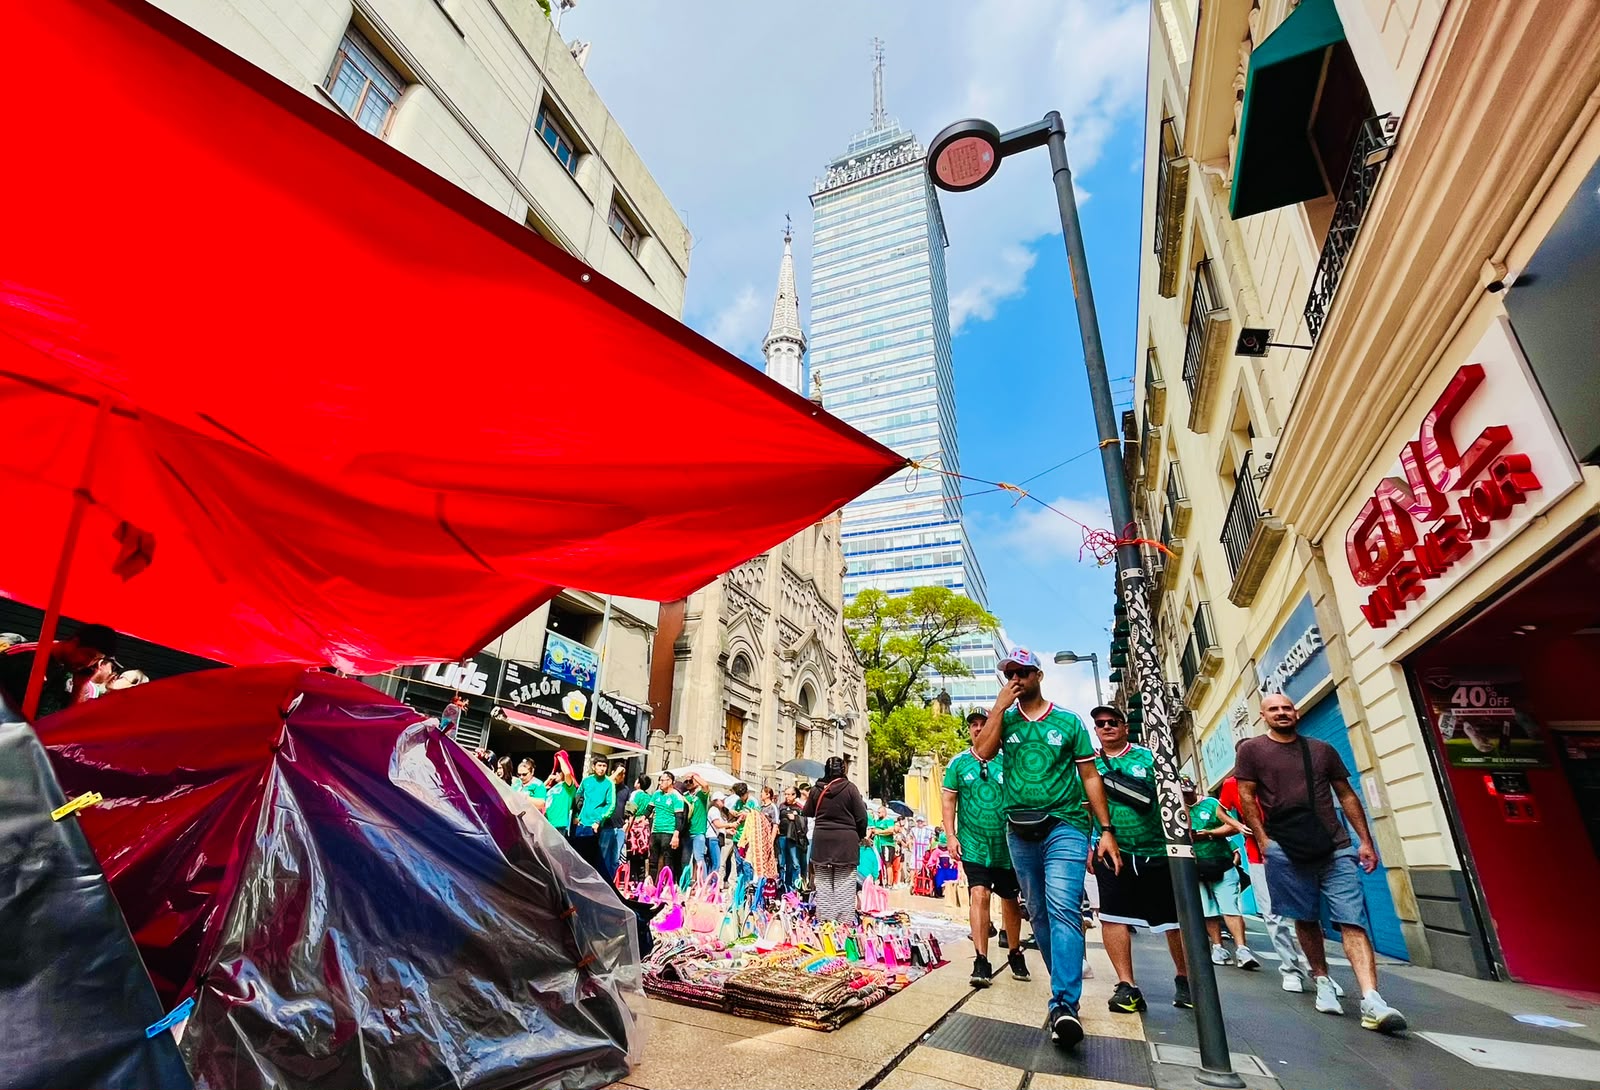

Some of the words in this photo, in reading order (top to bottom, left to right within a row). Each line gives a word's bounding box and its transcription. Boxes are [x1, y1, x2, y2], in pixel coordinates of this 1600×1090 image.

[1345, 363, 1513, 587] GNC
[1412, 453, 1542, 579] MEJOR
[1284, 624, 1324, 676] ESSENCE
[509, 676, 561, 707] SALÓN
[1489, 697, 1510, 707] OFF
